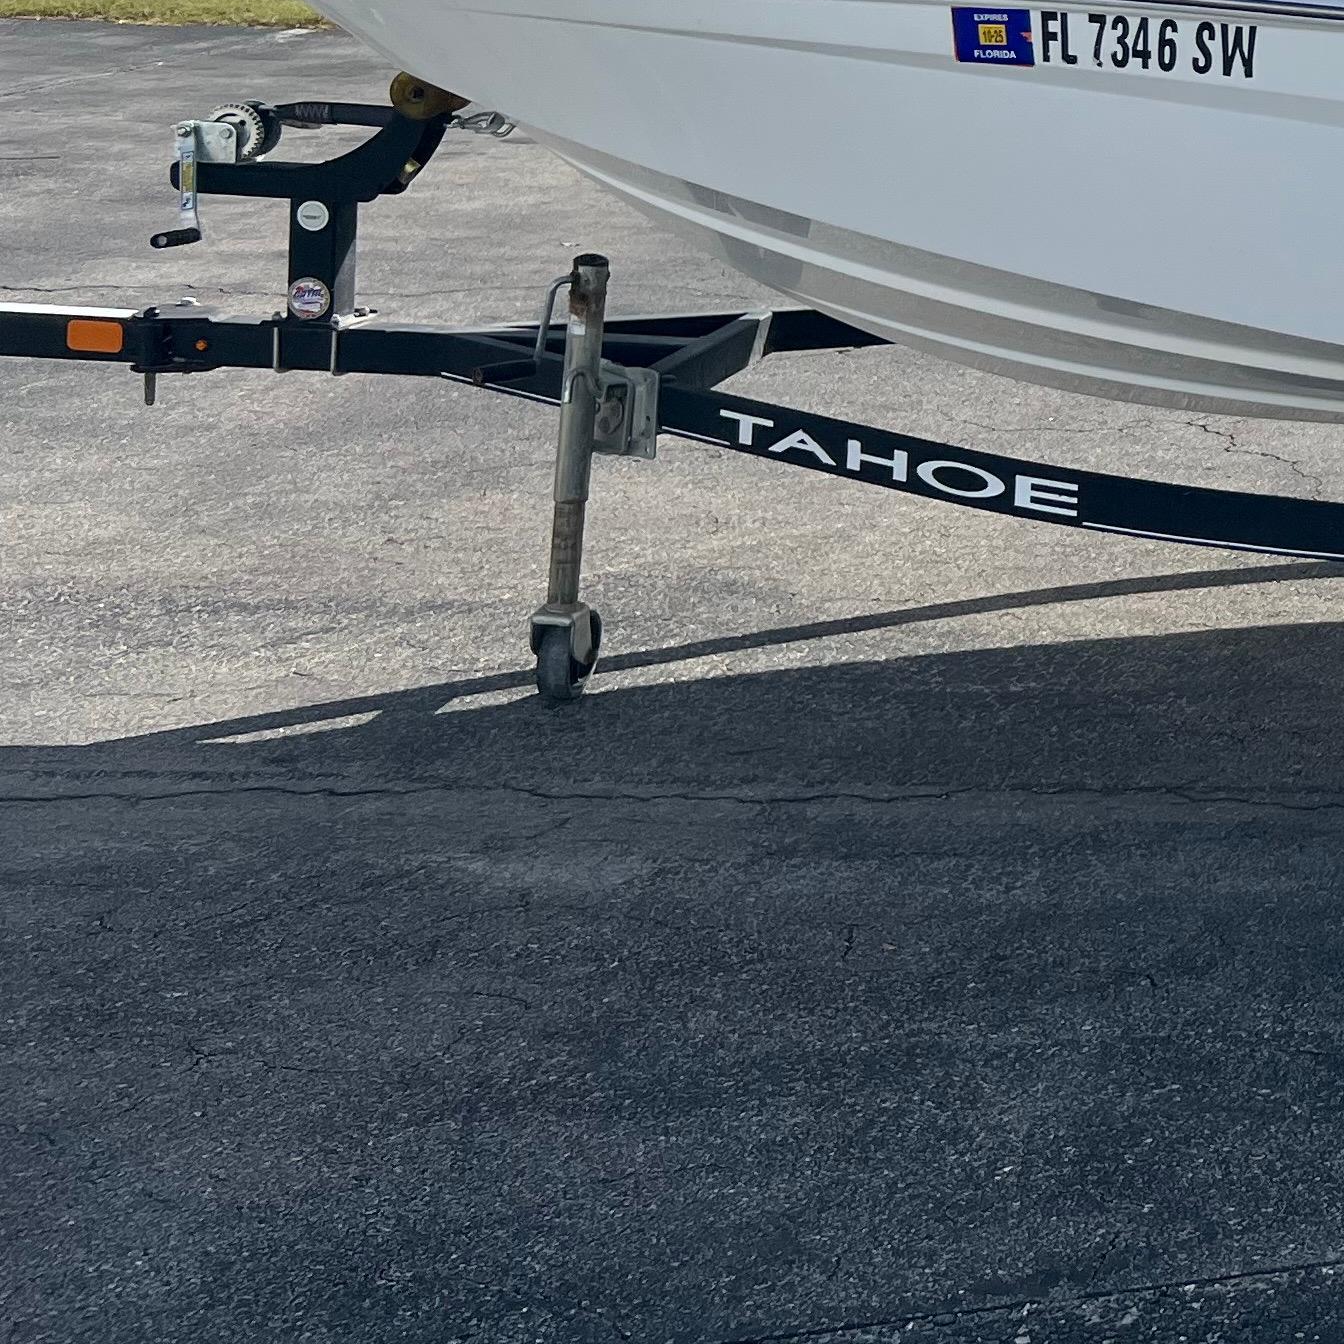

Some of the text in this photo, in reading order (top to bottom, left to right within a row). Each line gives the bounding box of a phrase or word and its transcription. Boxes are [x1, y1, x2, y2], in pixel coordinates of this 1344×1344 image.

[973, 13, 1009, 22] EXPIRES
[973, 49, 1017, 60] FLORIDA
[1041, 11, 1258, 79] FL 7346 SW
[719, 409, 1079, 518] TAHOE
